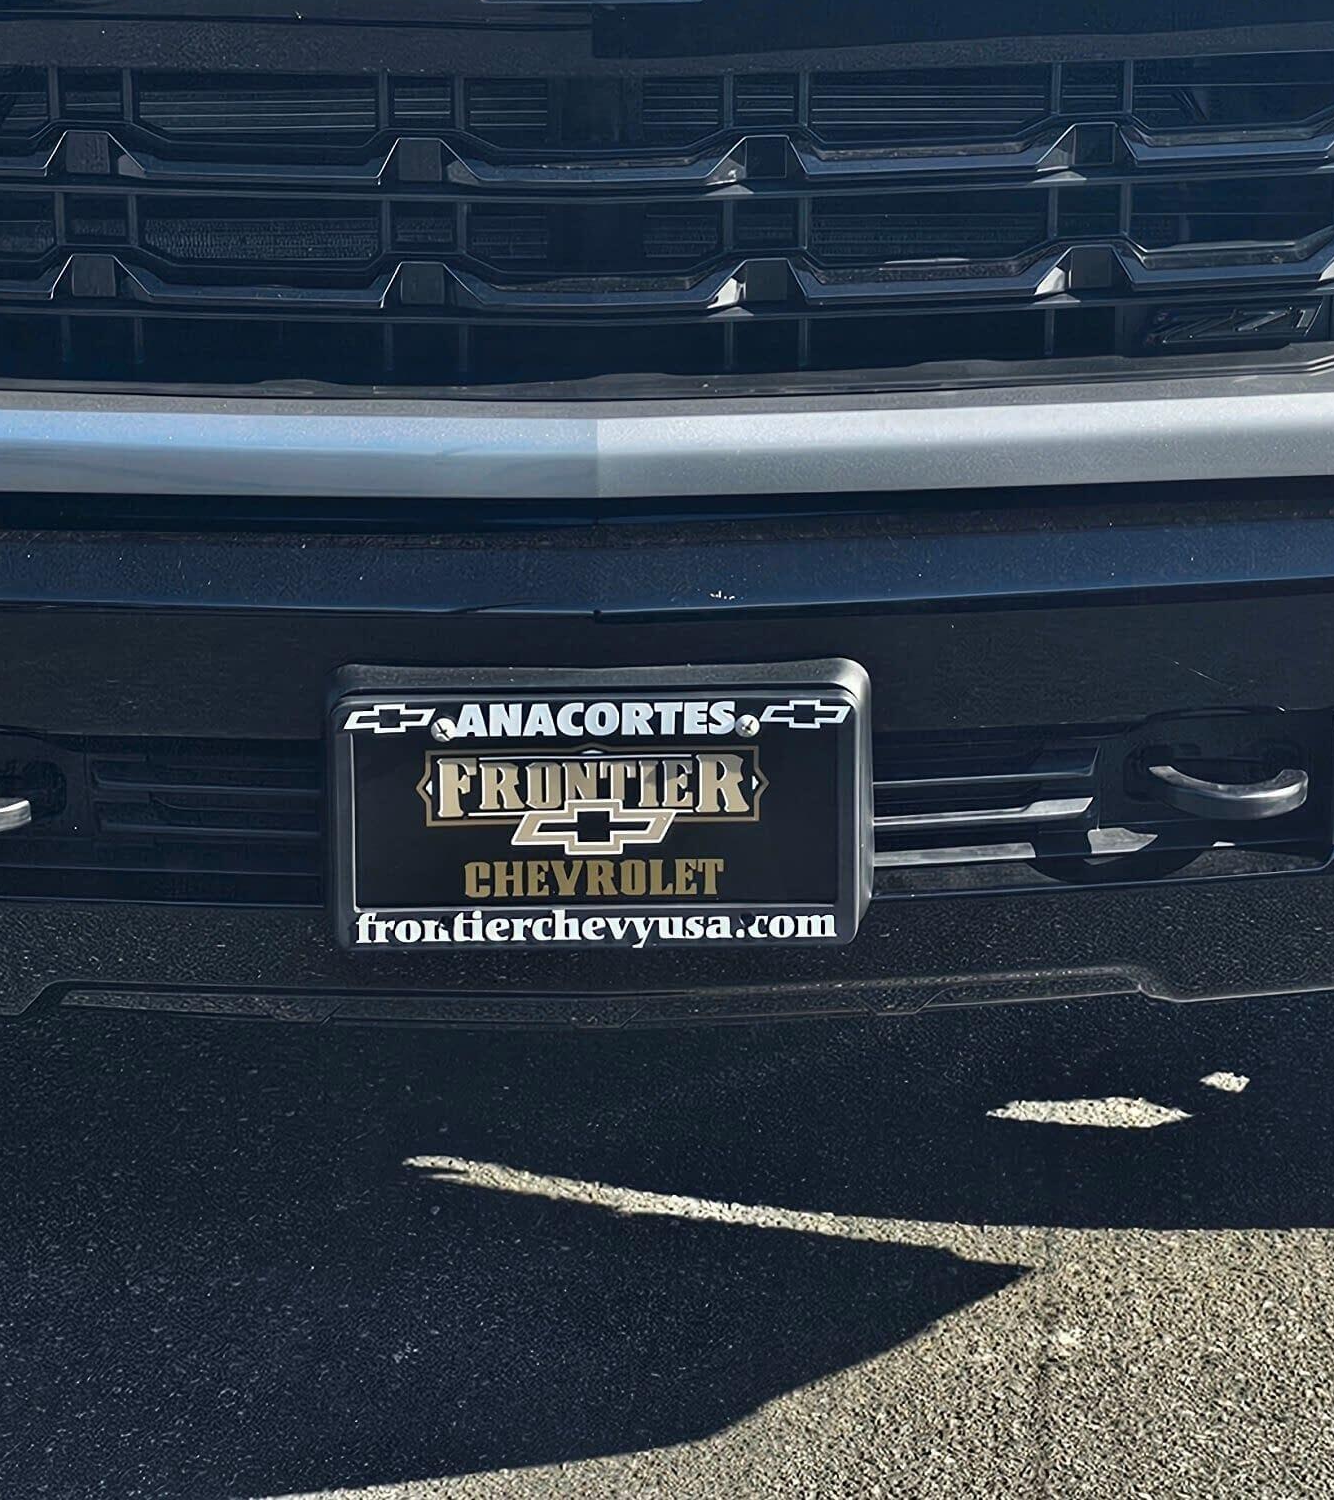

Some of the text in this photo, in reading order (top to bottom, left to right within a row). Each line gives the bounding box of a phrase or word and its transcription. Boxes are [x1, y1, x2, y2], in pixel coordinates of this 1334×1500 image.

[452, 701, 736, 738] ANACORTES
[435, 753, 750, 818] FRONTIER
[464, 858, 725, 898] CHEVROLET
[355, 910, 838, 949] frontierchevyusa.com
